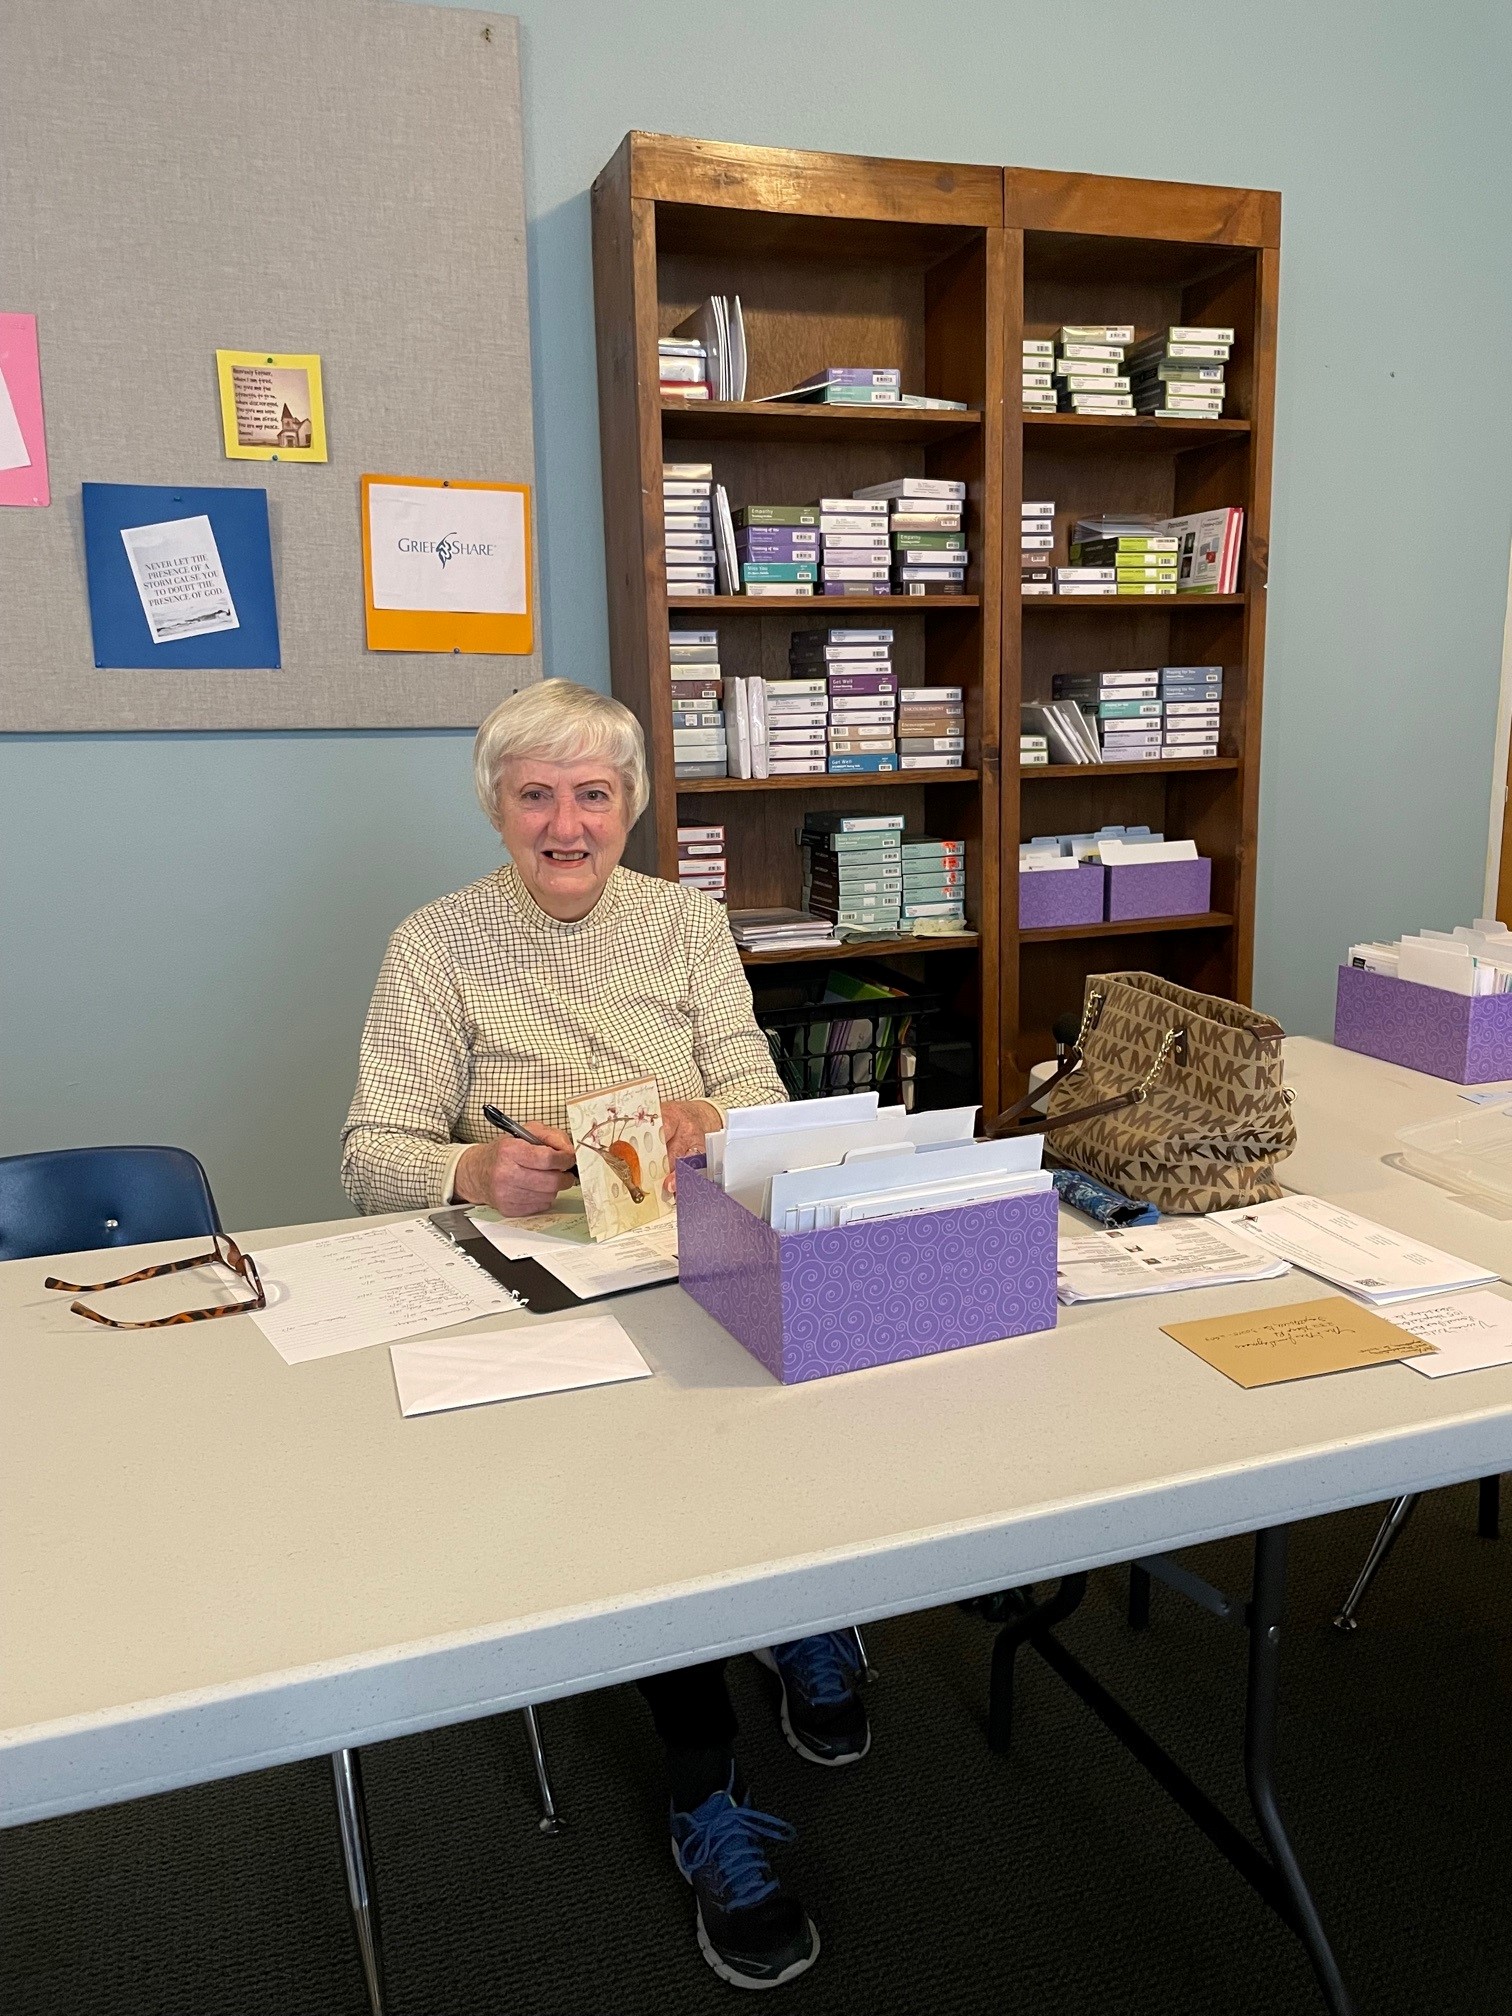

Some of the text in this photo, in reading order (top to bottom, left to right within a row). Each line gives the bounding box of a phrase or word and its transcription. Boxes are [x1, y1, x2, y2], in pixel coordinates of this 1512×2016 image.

[145, 554, 209, 571] NEVER LET THE
[148, 566, 190, 580] PRESENCE
[190, 564, 202, 572] OF
[143, 570, 219, 590] STORM CAUSE YOU
[154, 580, 216, 597] TO DOUBT THE
[148, 594, 191, 607] PRESENCE
[191, 590, 203, 599] OF
[1142, 996, 1173, 1029] MK
[1199, 1020, 1232, 1054] MK
[1120, 1018, 1154, 1050] MK
[1213, 1055, 1251, 1088] MK
[1097, 1038, 1130, 1069] MK
[1193, 1076, 1224, 1110] MK
[1096, 1121, 1132, 1151] MK
[1122, 1133, 1162, 1160] MK
[1164, 1141, 1210, 1162] MK
[1104, 1152, 1138, 1182] MK
[1140, 1161, 1186, 1185] MK
[1189, 1163, 1235, 1190] MK
